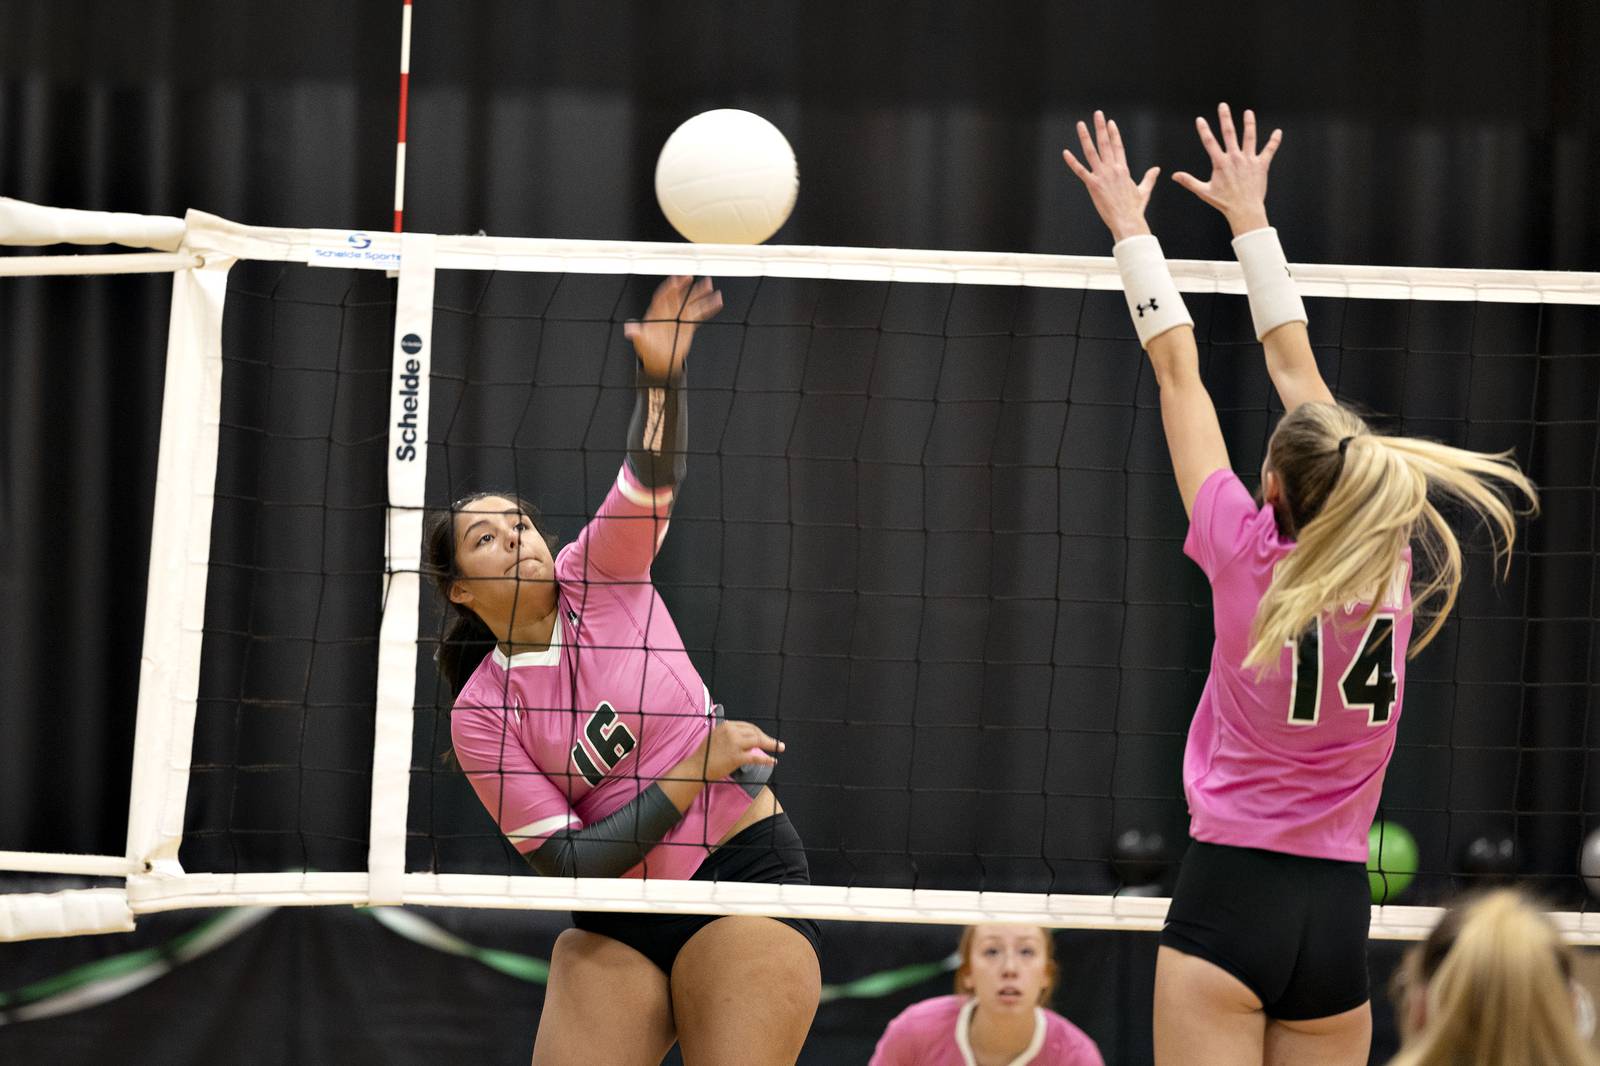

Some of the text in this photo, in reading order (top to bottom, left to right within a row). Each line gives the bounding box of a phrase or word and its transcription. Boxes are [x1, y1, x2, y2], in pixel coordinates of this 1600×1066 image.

[315, 249, 361, 258] Schelde
[396, 359, 420, 462] Schelde
[1284, 612, 1397, 727] 14
[572, 701, 637, 788] 16
